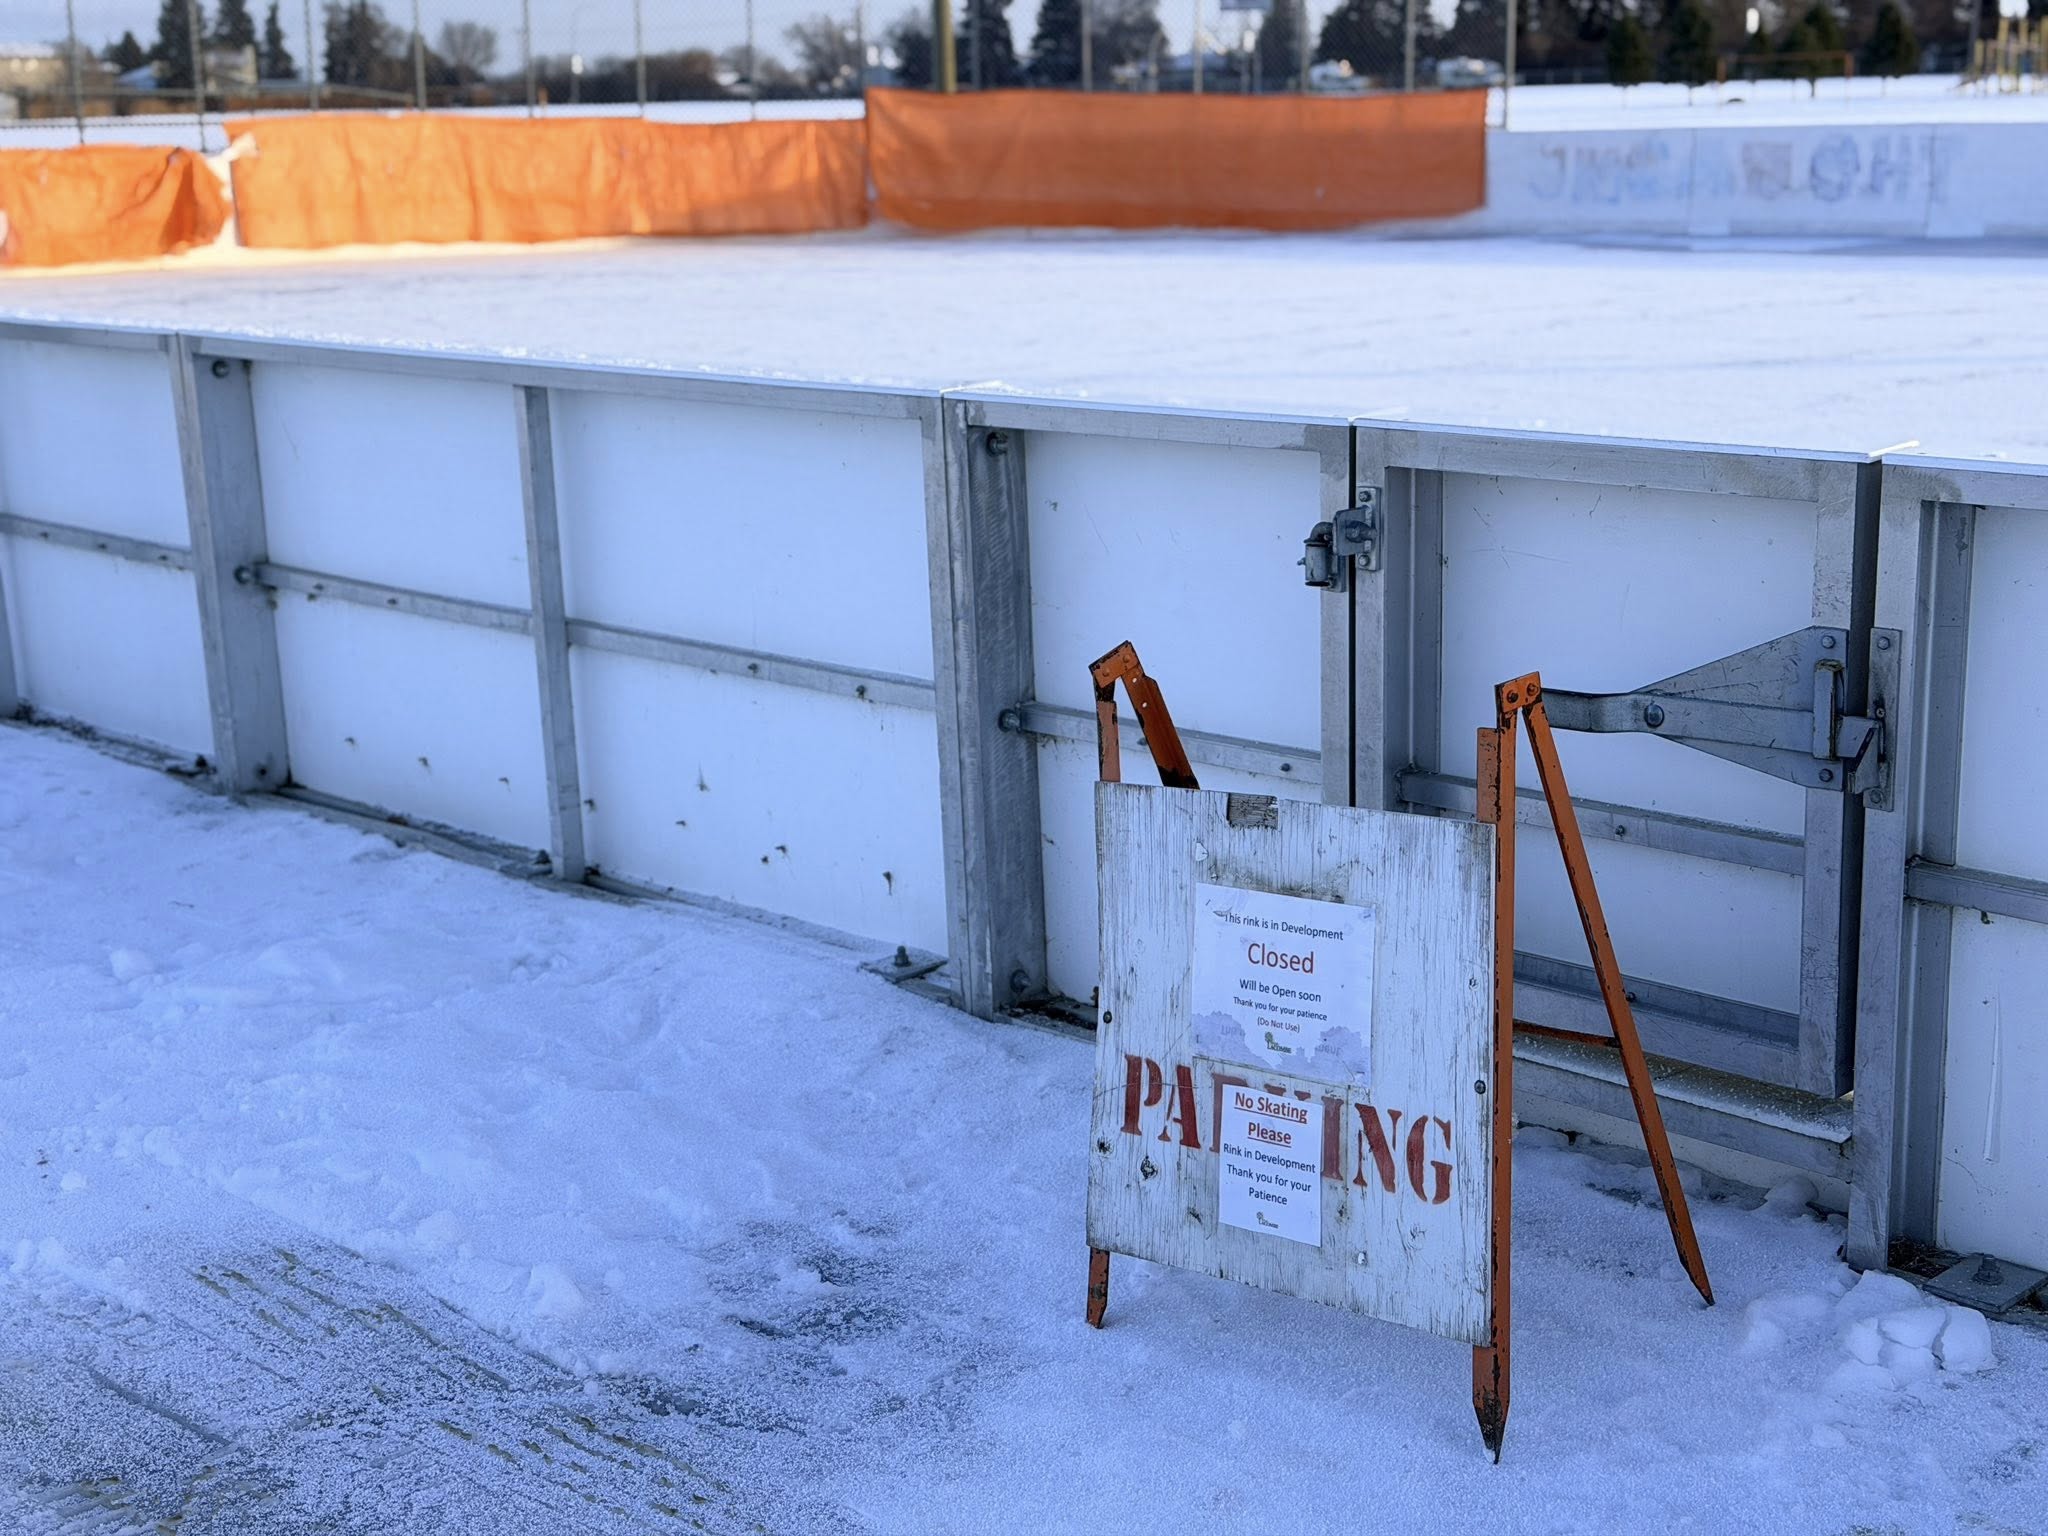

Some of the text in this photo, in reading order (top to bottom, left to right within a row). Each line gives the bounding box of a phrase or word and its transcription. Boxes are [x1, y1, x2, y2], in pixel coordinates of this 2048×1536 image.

[1243, 915, 1260, 928] rink
[1262, 918, 1269, 929] is
[1271, 919, 1279, 931] in
[1281, 921, 1344, 941] Development
[1248, 943, 1314, 974] Closed
[1239, 979, 1322, 1003] Will be Open soon
[1233, 996, 1328, 1022] Thank you for your patience
[1257, 1017, 1301, 1034] (Do Not Use)
[1235, 1092, 1308, 1125] No Skating
[1248, 1122, 1292, 1145] Please
[1223, 1143, 1316, 1174] Rink in Development
[1226, 1164, 1312, 1193] Thank you for your
[1249, 1187, 1288, 1205] Patience
